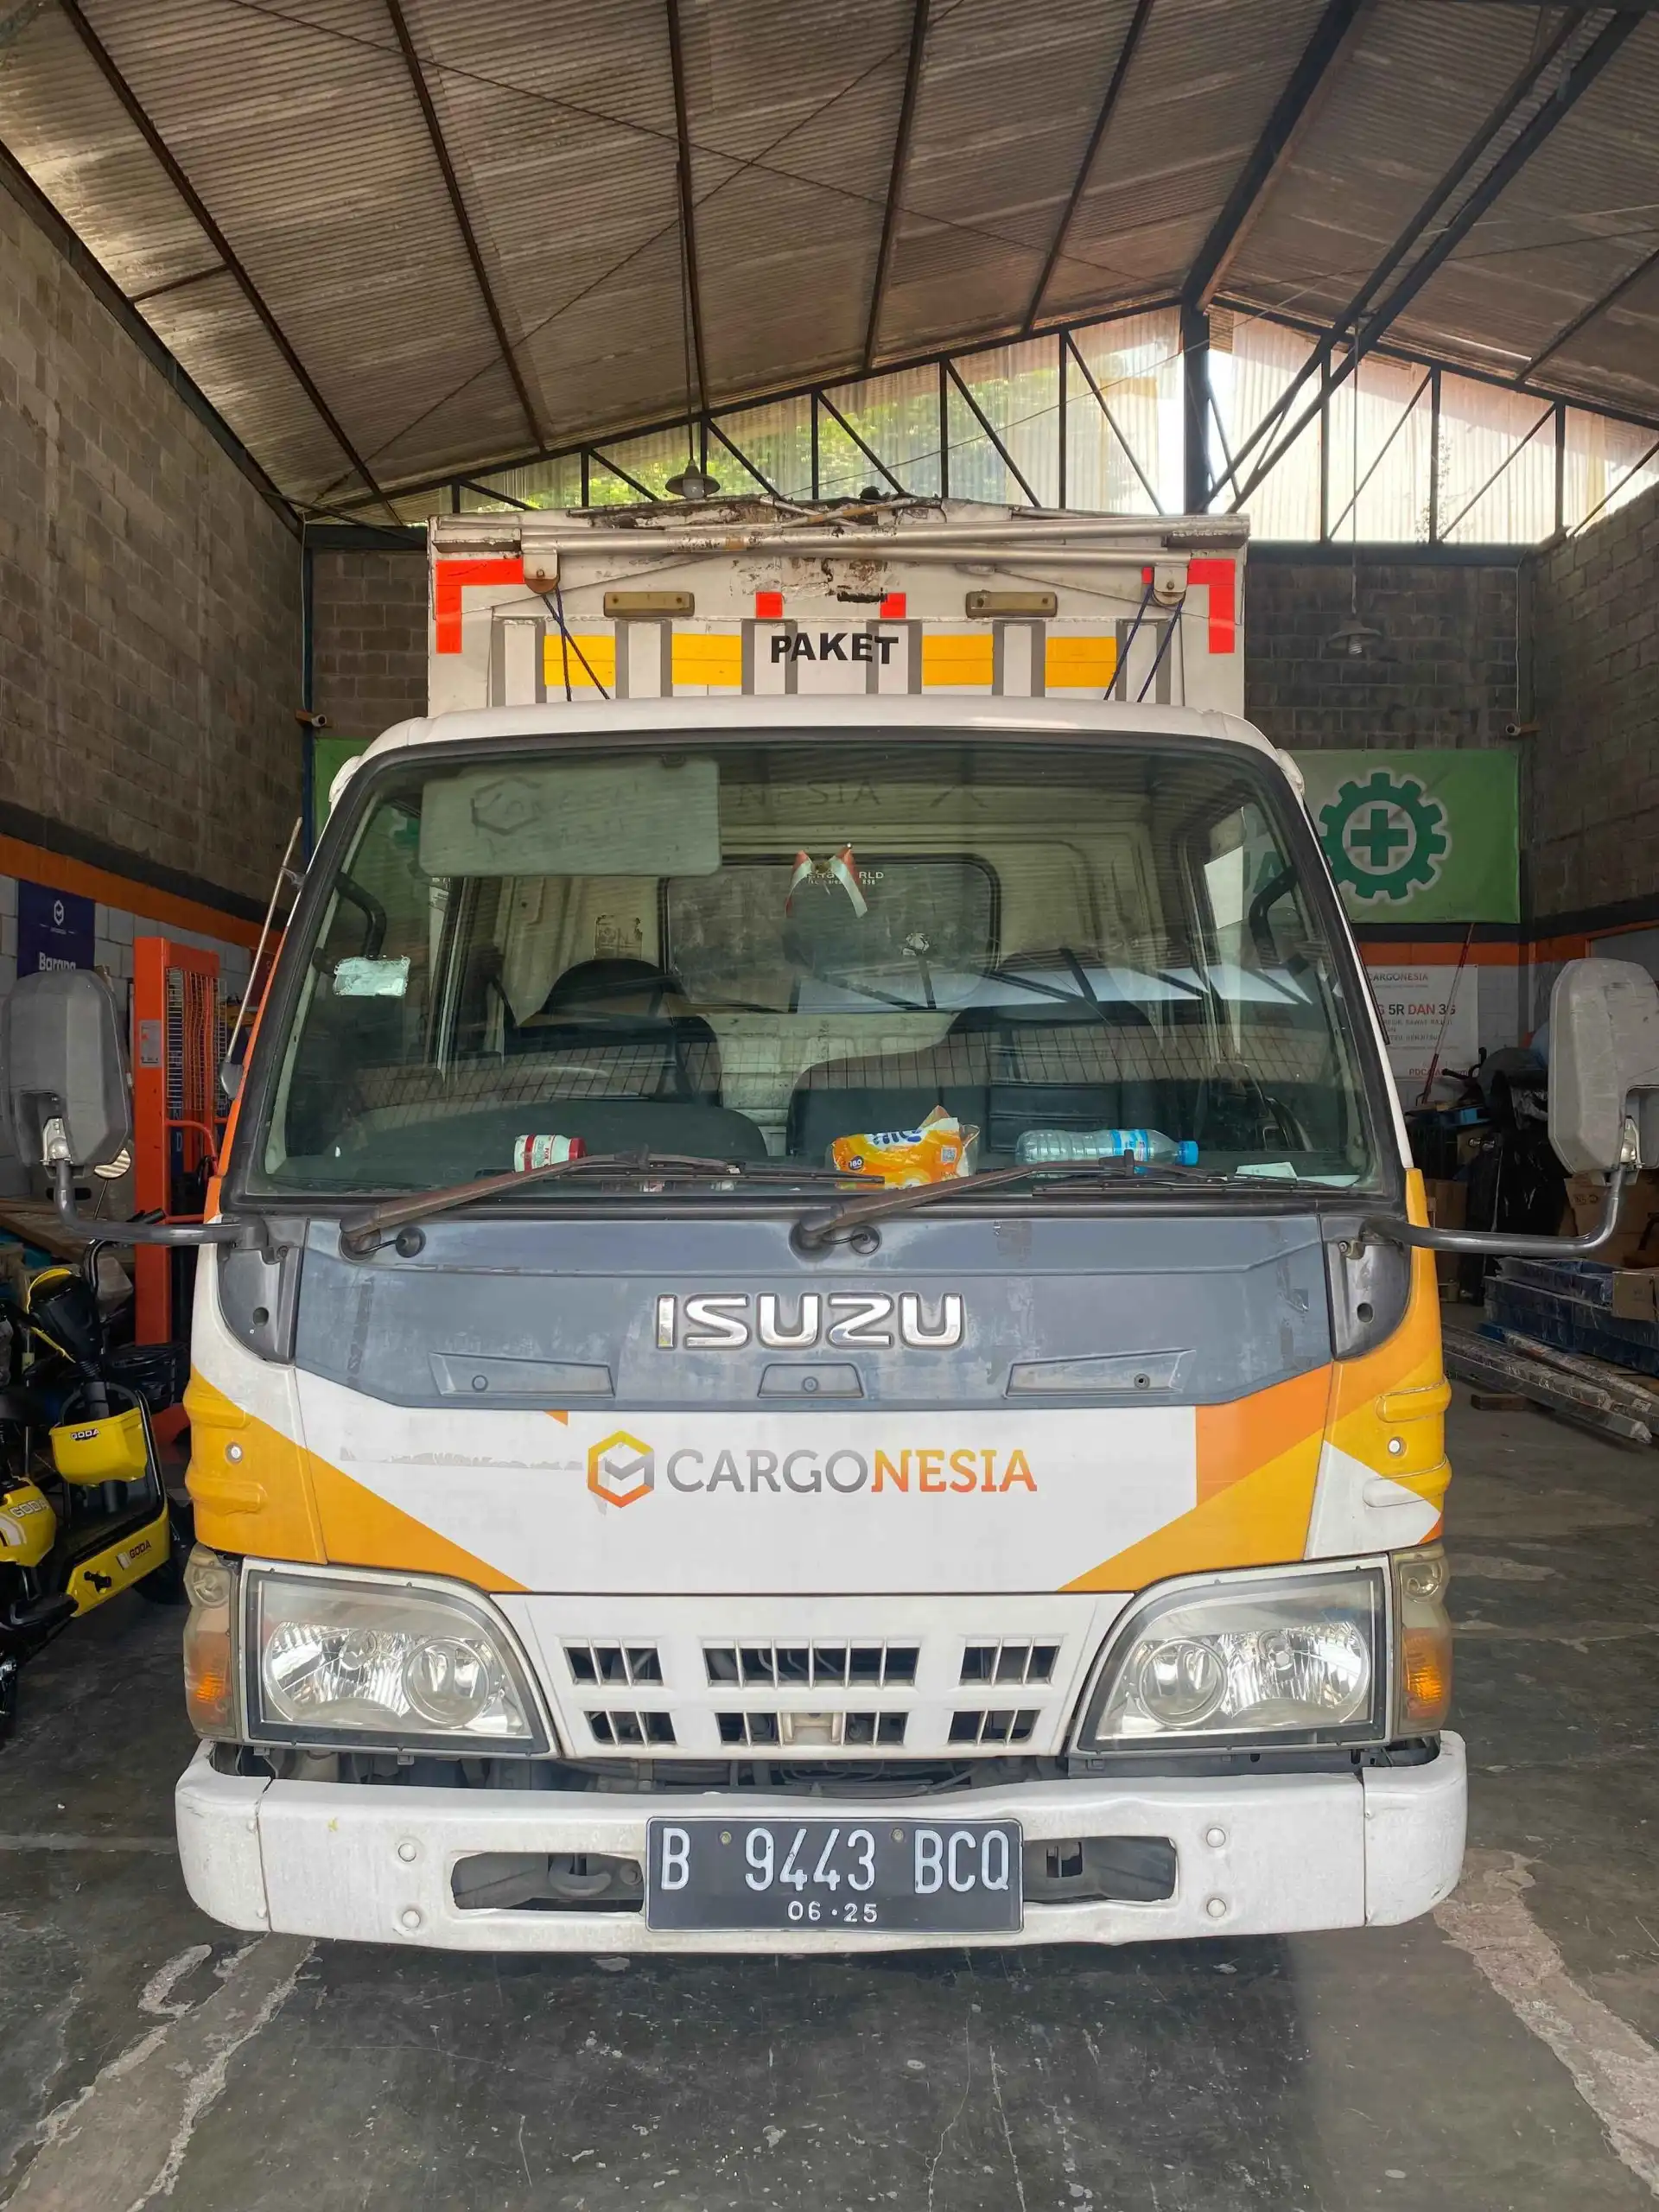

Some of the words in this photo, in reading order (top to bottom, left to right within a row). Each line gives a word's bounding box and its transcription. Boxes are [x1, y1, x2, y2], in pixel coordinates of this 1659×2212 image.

[771, 632, 899, 664] PAKET
[1389, 1004, 1405, 1015] 5R
[1408, 1004, 1435, 1015] DAN
[655, 1293, 963, 1349] ISUZU
[70, 1428, 100, 1440] GODA
[666, 1448, 1038, 1493] CARGONESIA
[10, 1499, 49, 1518] GODA
[130, 1539, 152, 1559] GODA
[661, 1827, 690, 1891] B
[745, 1827, 876, 1891] 9443
[914, 1829, 1010, 1894] BCQ
